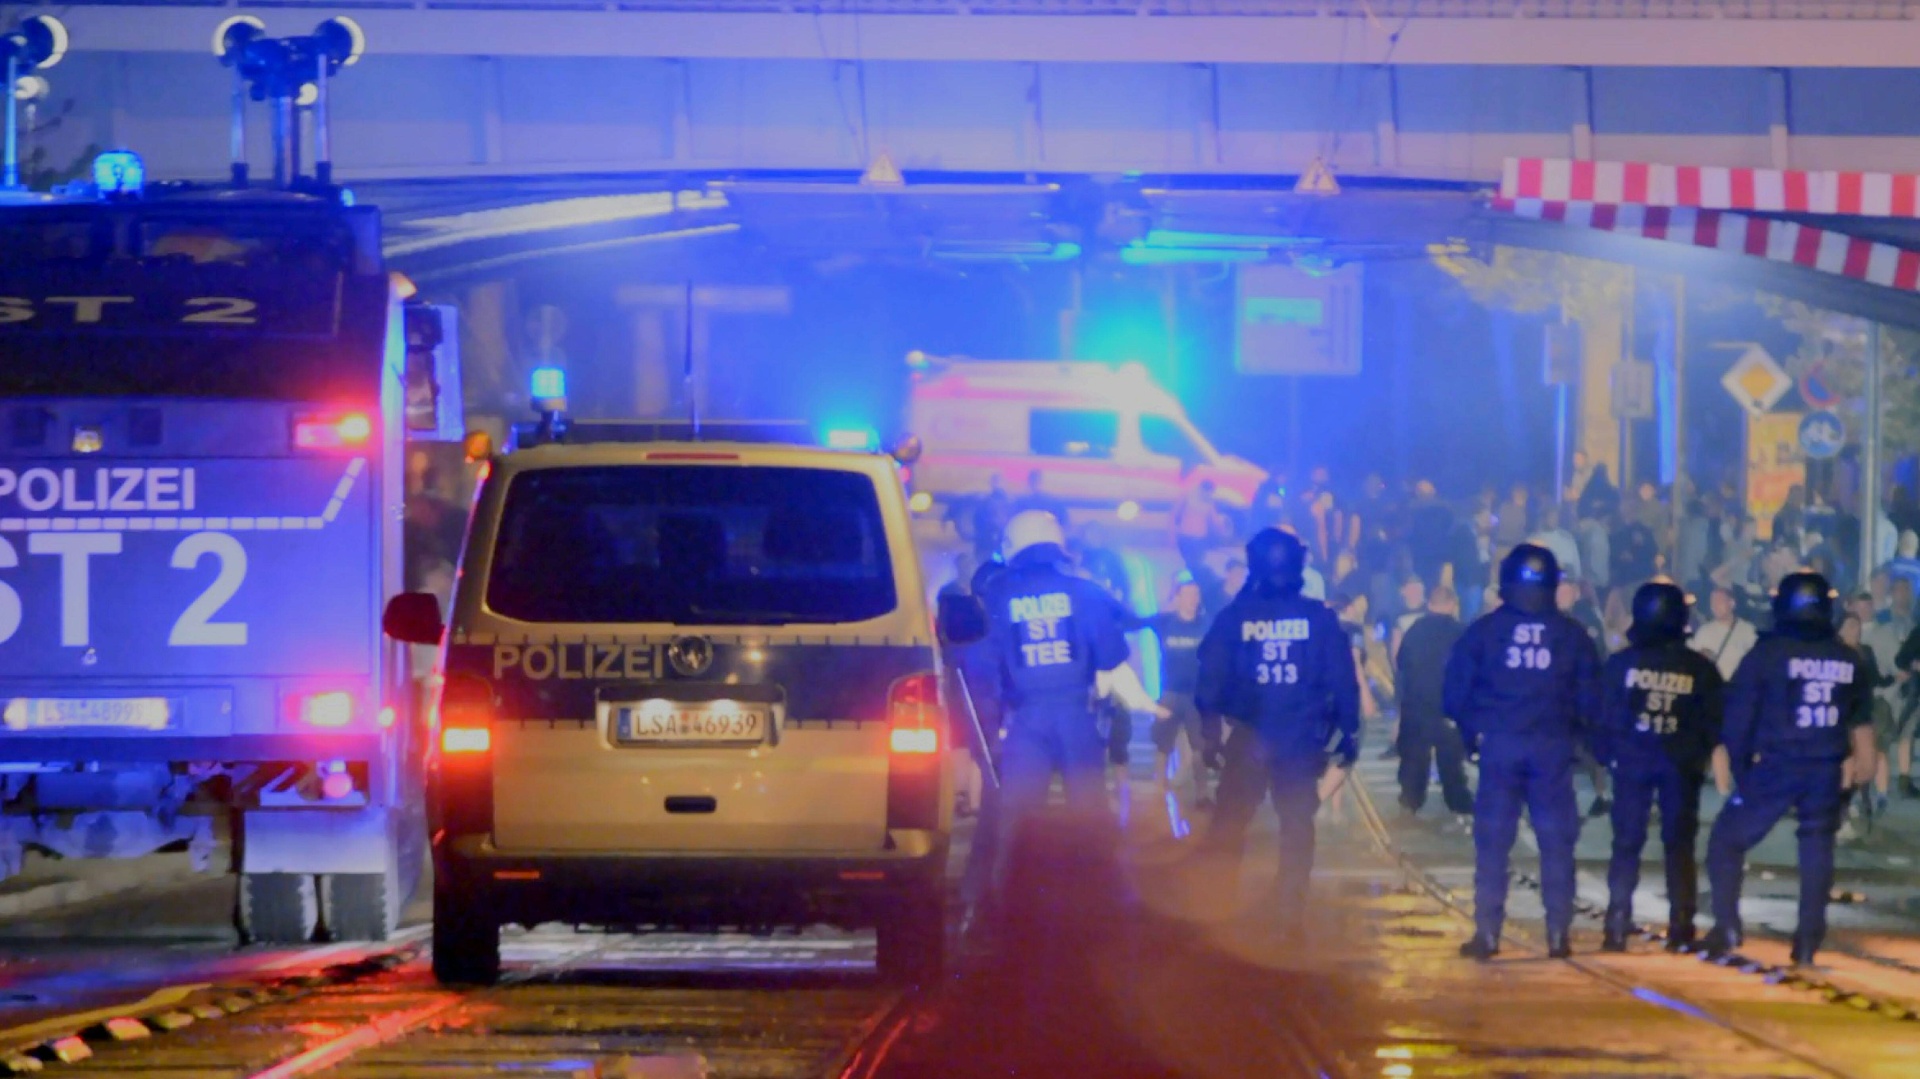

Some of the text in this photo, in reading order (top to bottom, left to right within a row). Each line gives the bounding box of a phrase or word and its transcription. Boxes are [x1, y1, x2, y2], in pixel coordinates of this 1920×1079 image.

[182, 296, 257, 323] 2
[0, 531, 248, 647] T 2
[1010, 592, 1072, 623] POLIZEI
[1027, 617, 1058, 641] ST
[1242, 618, 1309, 642] POLIZEI
[1513, 623, 1545, 645] ST
[494, 645, 664, 680] POLIZEI
[1021, 639, 1072, 667] TEE
[1262, 640, 1292, 661] ST
[1506, 646, 1552, 670] 310
[1257, 663, 1298, 684] 313
[1625, 668, 1694, 694] POLIZEI
[1788, 657, 1854, 684] POLIZEI
[1646, 692, 1678, 713] ST
[1803, 681, 1835, 703] ST
[635, 713, 677, 735] LSA
[1635, 712, 1678, 734] 313
[1796, 705, 1839, 728] 310
